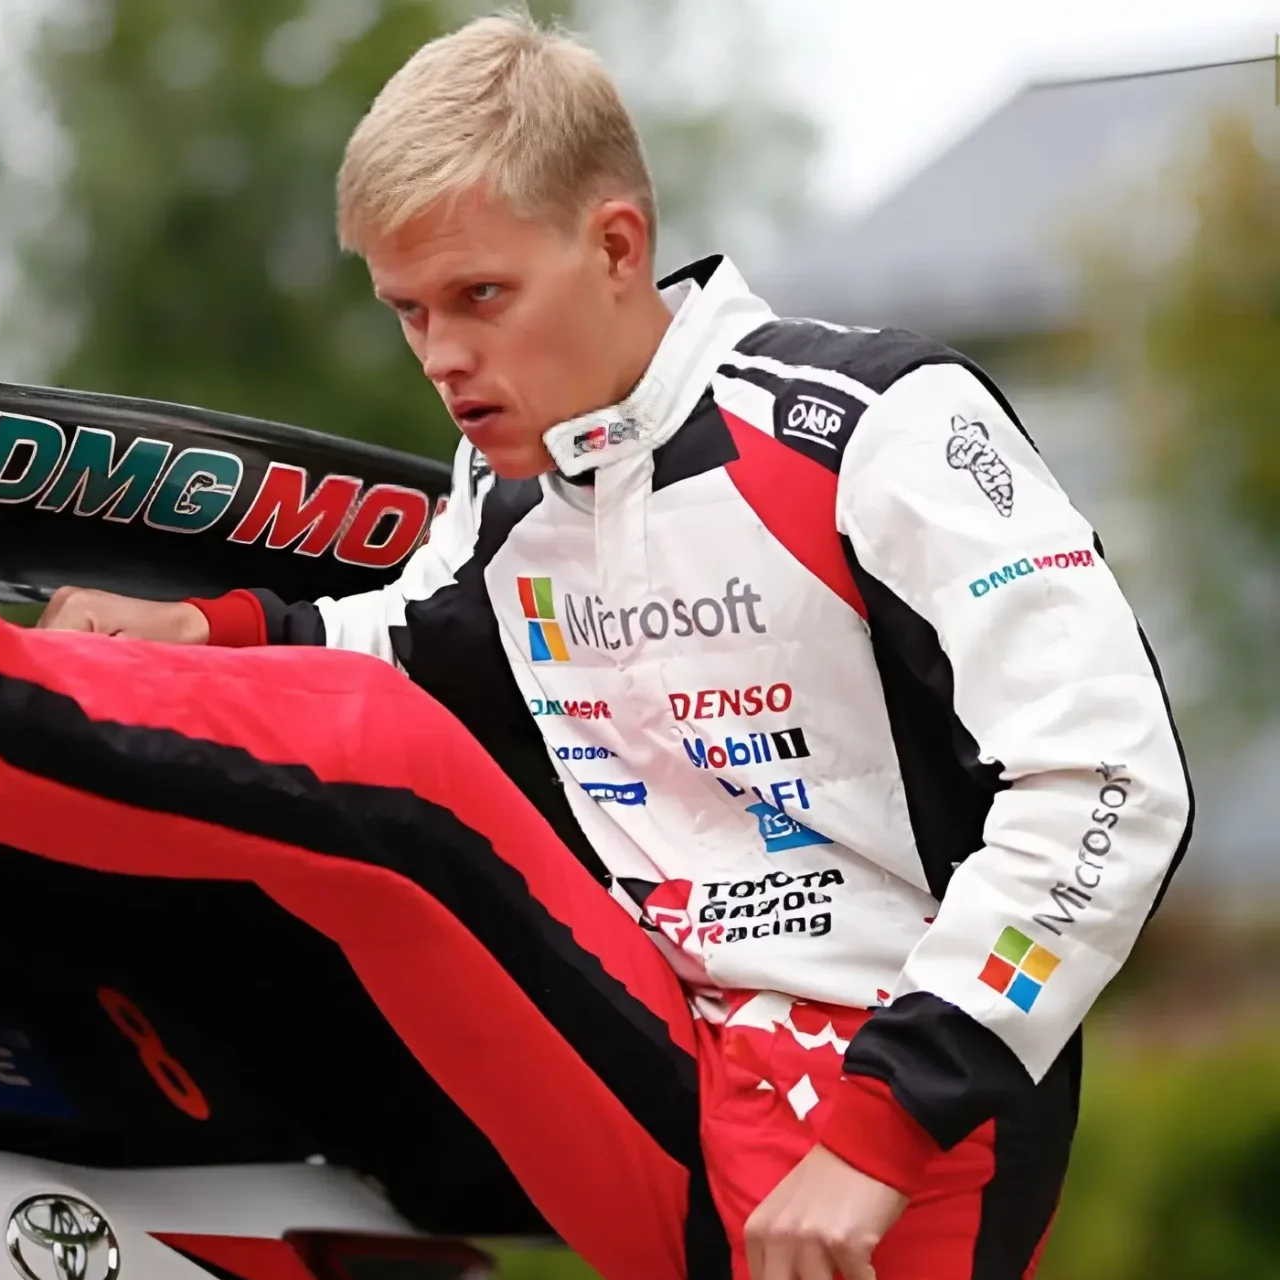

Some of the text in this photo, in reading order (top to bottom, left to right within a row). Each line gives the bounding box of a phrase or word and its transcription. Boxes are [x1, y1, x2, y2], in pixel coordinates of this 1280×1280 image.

[565, 577, 767, 650] Microsoft
[668, 682, 793, 721] DENSO
[702, 869, 845, 899] TOYOTA
[697, 912, 832, 949] Racing
[96, 986, 210, 1121] 8
